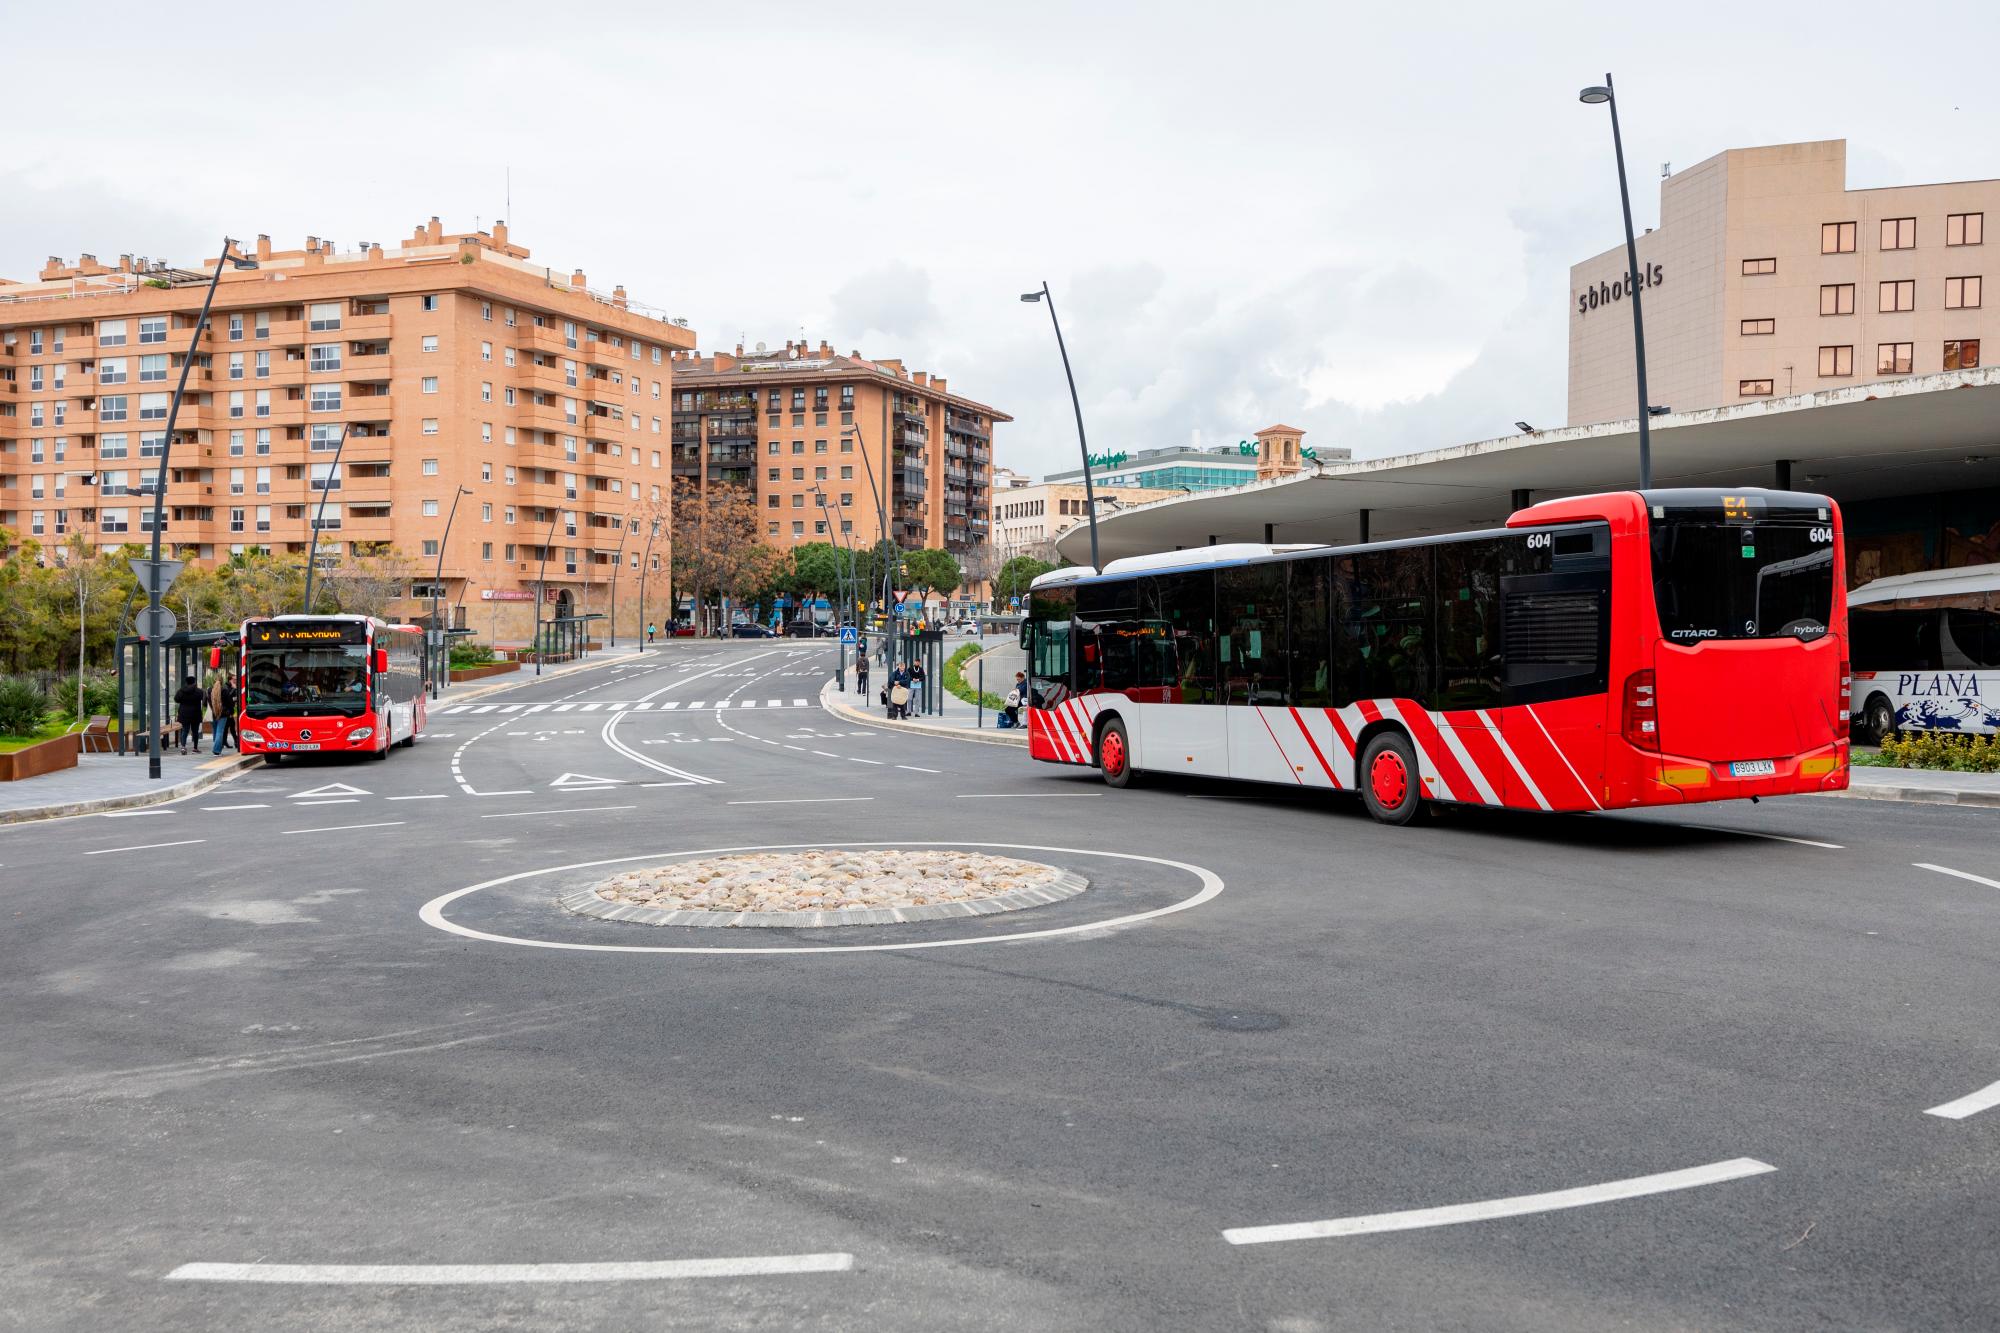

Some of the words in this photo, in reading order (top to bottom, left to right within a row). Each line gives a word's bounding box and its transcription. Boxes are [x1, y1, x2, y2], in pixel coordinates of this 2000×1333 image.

[1578, 262, 1663, 313] sbhotels
[1527, 533, 1551, 549] 604
[1809, 528, 1833, 543] 604
[1671, 629, 1718, 638] CITARO
[1793, 625, 1825, 636] hybrid
[1897, 673, 1980, 697] PLANA
[266, 721, 284, 729] 603
